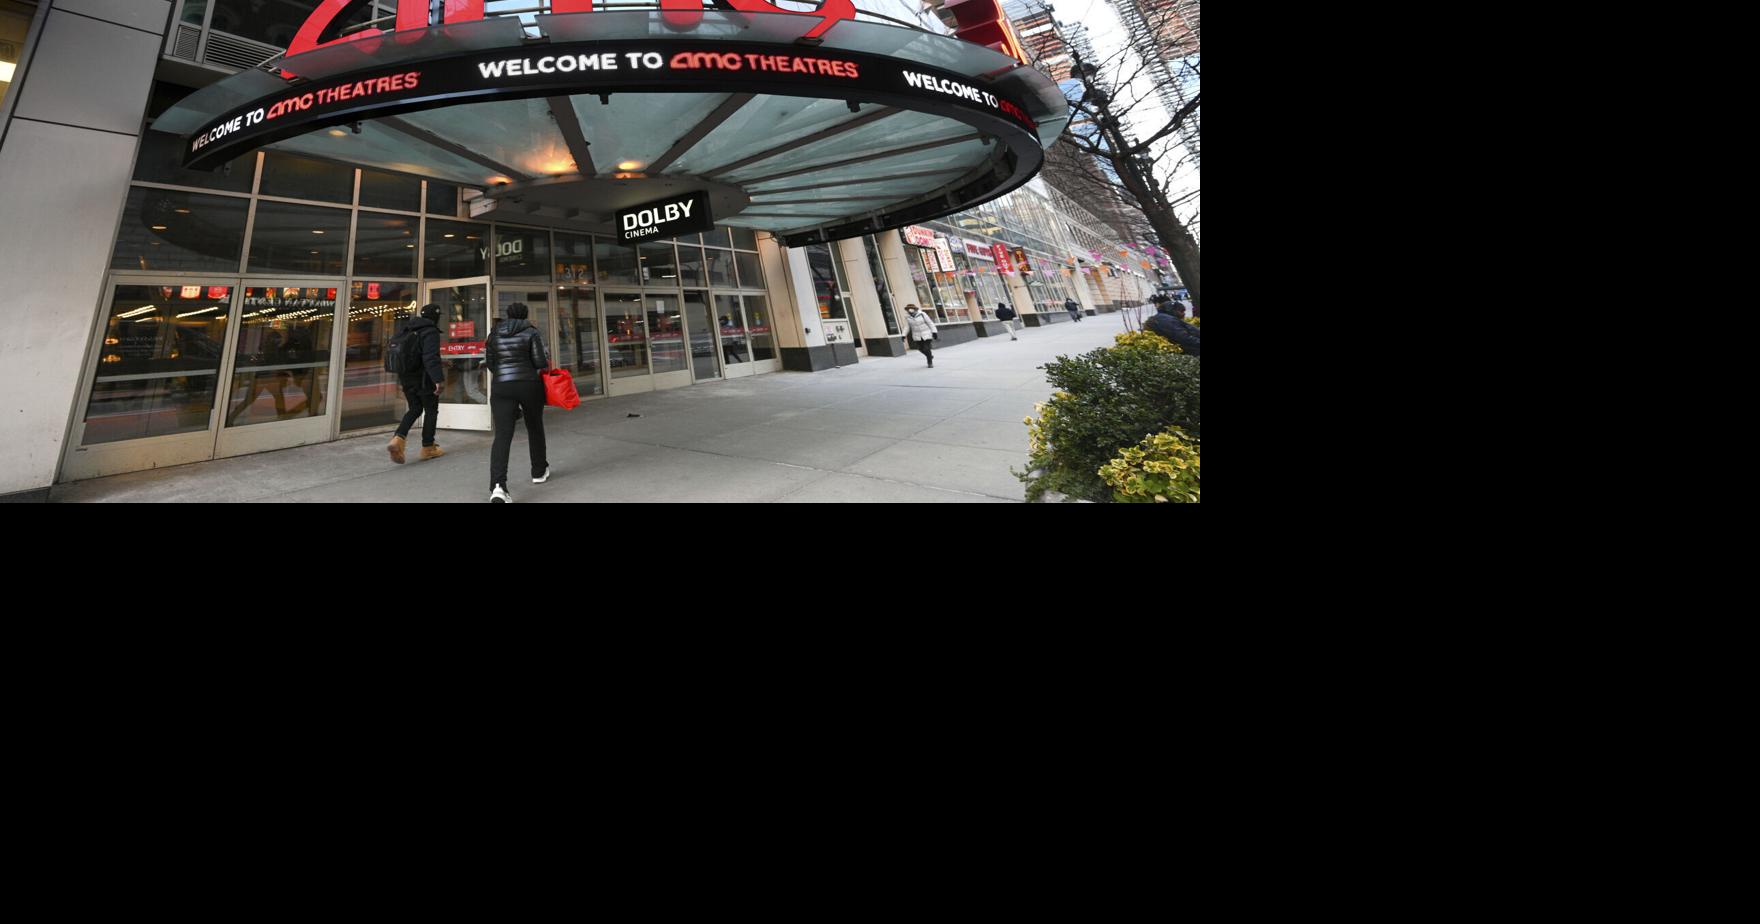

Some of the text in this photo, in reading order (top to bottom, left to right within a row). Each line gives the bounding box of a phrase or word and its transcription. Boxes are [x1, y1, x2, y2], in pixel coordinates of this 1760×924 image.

[478, 53, 618, 79] WELCOME
[625, 52, 664, 69] TO
[744, 54, 860, 79] THEATRES
[902, 70, 983, 103] WELCOME
[982, 91, 999, 108] TO
[191, 115, 243, 152] WELCOME
[245, 107, 264, 127] TO
[317, 72, 421, 104] THEATRES
[622, 199, 694, 232] DOLBY
[624, 225, 659, 240] CINEMA
[564, 265, 585, 280] 312
